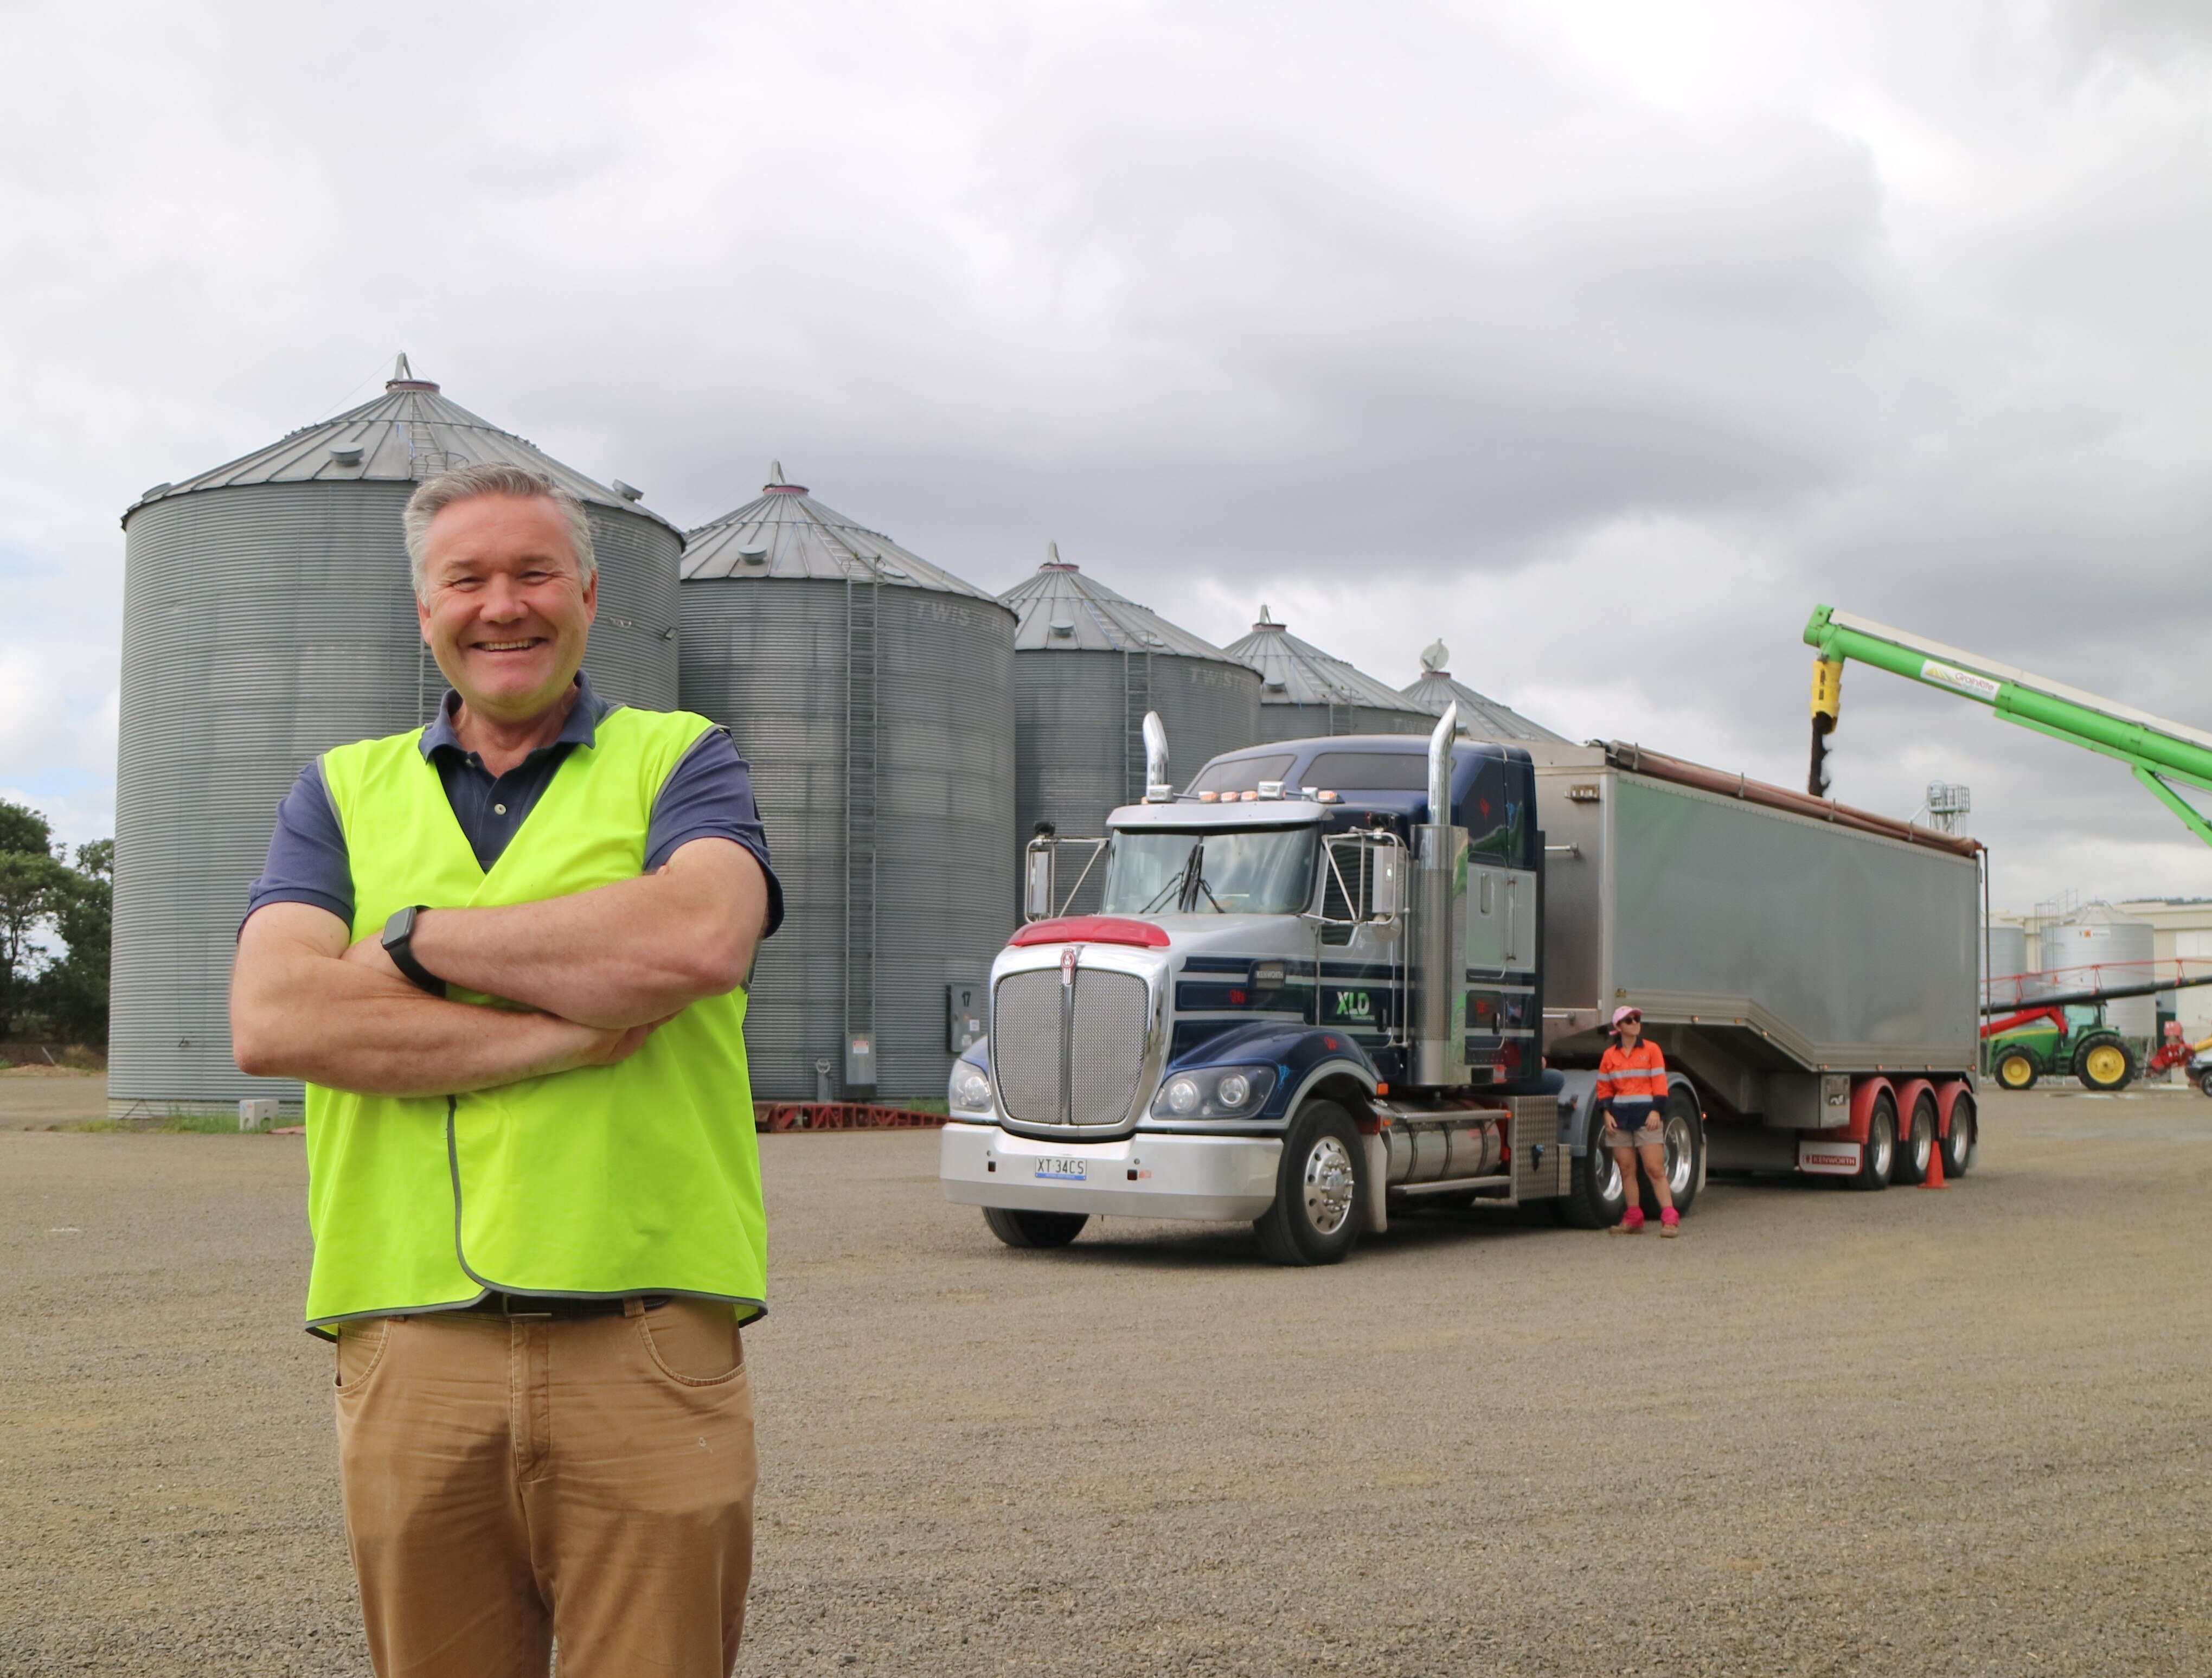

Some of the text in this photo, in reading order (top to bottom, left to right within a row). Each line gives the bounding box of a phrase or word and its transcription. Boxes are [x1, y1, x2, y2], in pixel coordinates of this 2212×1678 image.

[1256, 970, 1284, 979] KENWORTH
[1336, 991, 1370, 1015] XLD
[1813, 1155, 1855, 1165] KENWORTH
